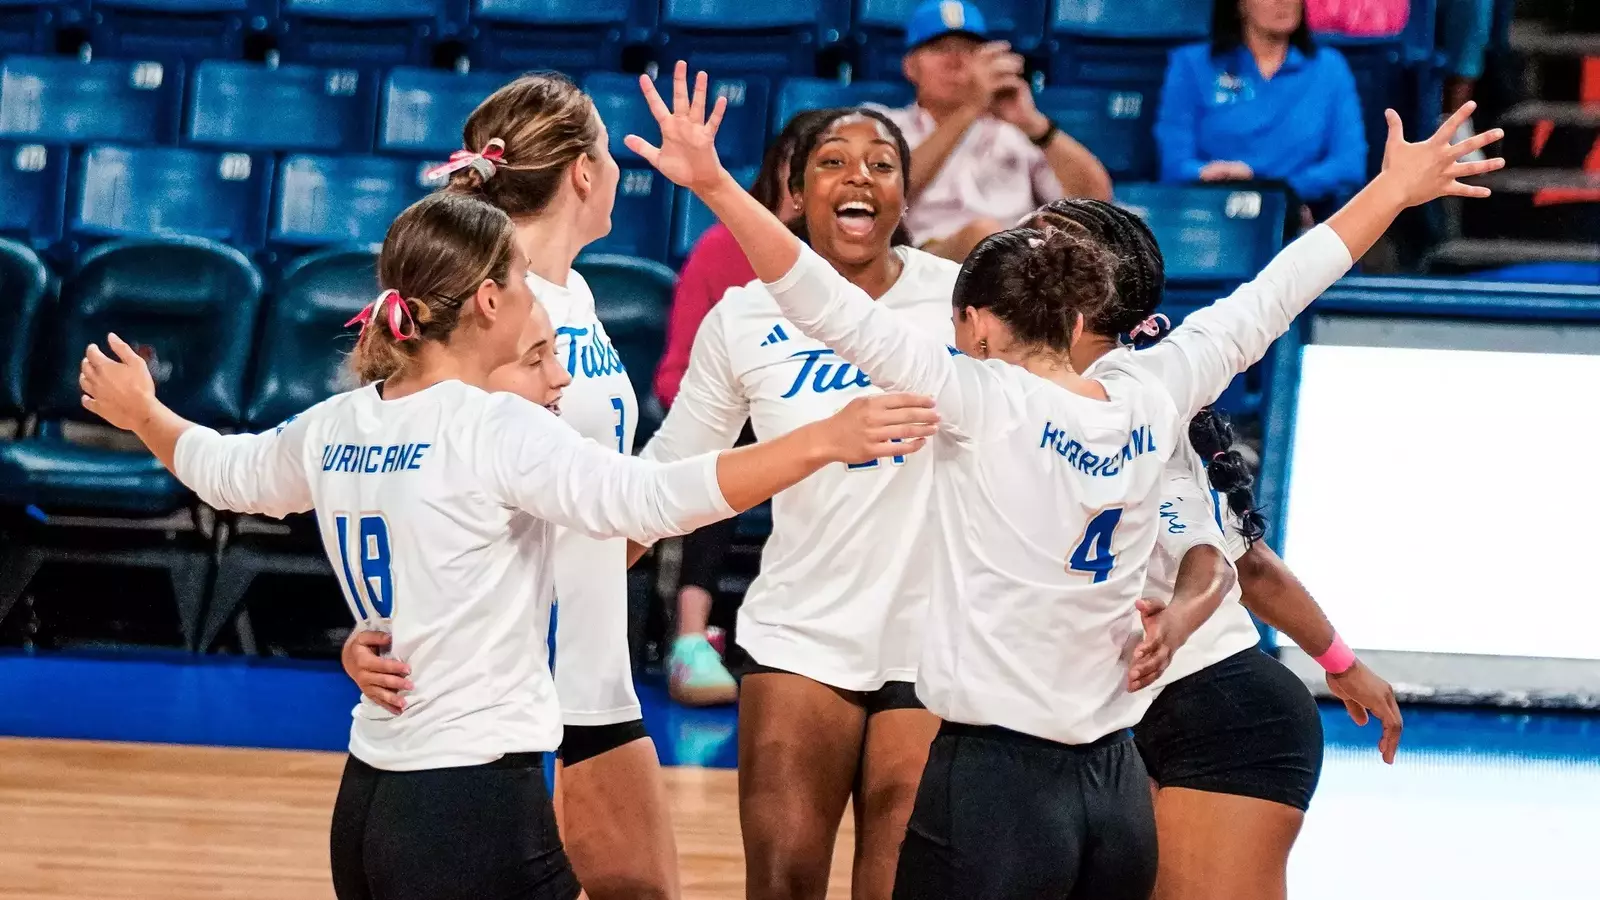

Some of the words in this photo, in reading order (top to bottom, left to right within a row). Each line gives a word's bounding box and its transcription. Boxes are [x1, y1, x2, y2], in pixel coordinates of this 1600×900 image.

[556, 323, 625, 378] Tuls
[334, 514, 396, 622] 18
[1068, 507, 1124, 585] 4
